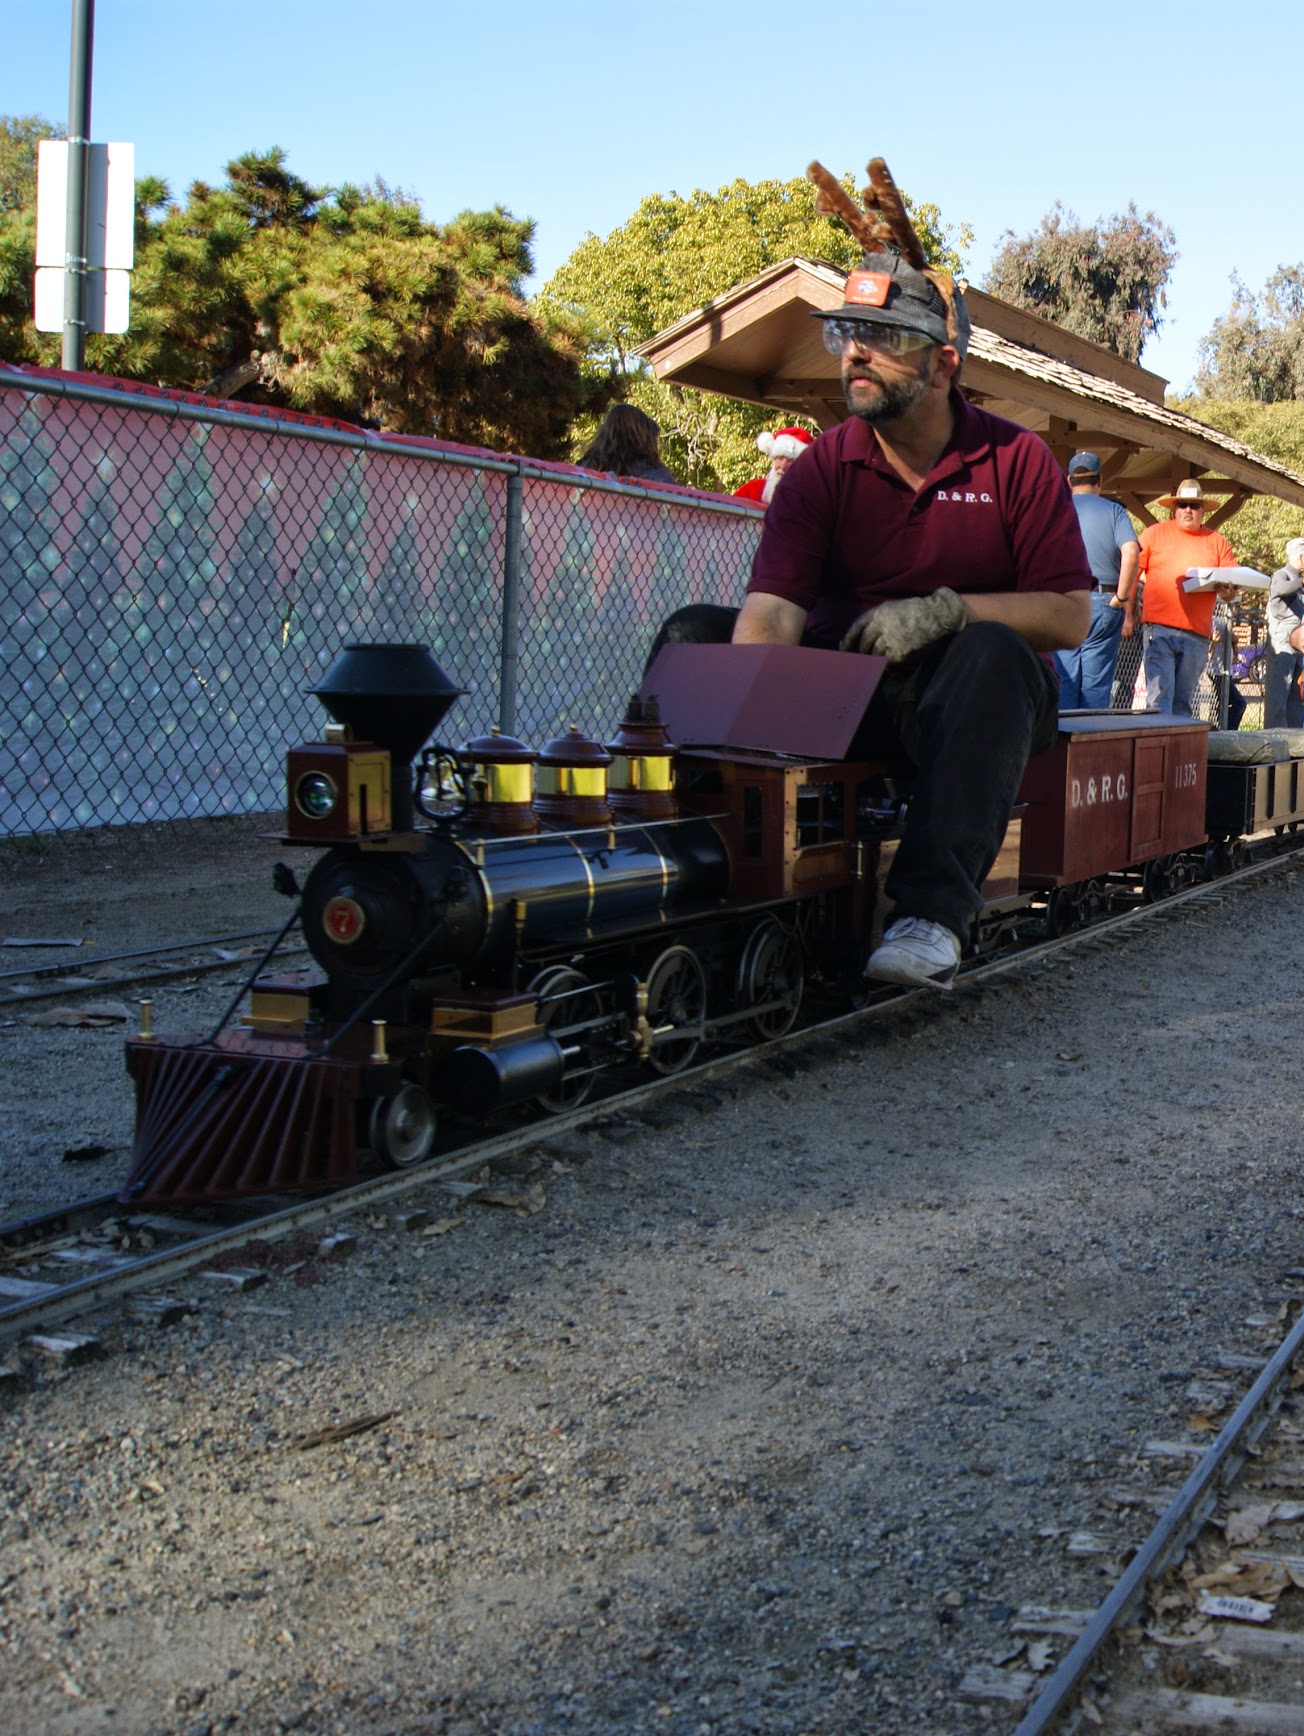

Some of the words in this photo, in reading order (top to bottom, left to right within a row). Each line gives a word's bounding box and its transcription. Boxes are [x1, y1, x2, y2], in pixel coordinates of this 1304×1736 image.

[937, 490, 949, 501] D.
[951, 491, 962, 502] &
[965, 492, 978, 503] R.
[980, 492, 993, 503] G.
[1175, 763, 1197, 789] 11375
[1071, 779, 1083, 808] D.
[1086, 778, 1097, 805] &
[1101, 775, 1114, 802] R.
[1116, 773, 1128, 800] G.
[335, 910, 350, 933] 7
